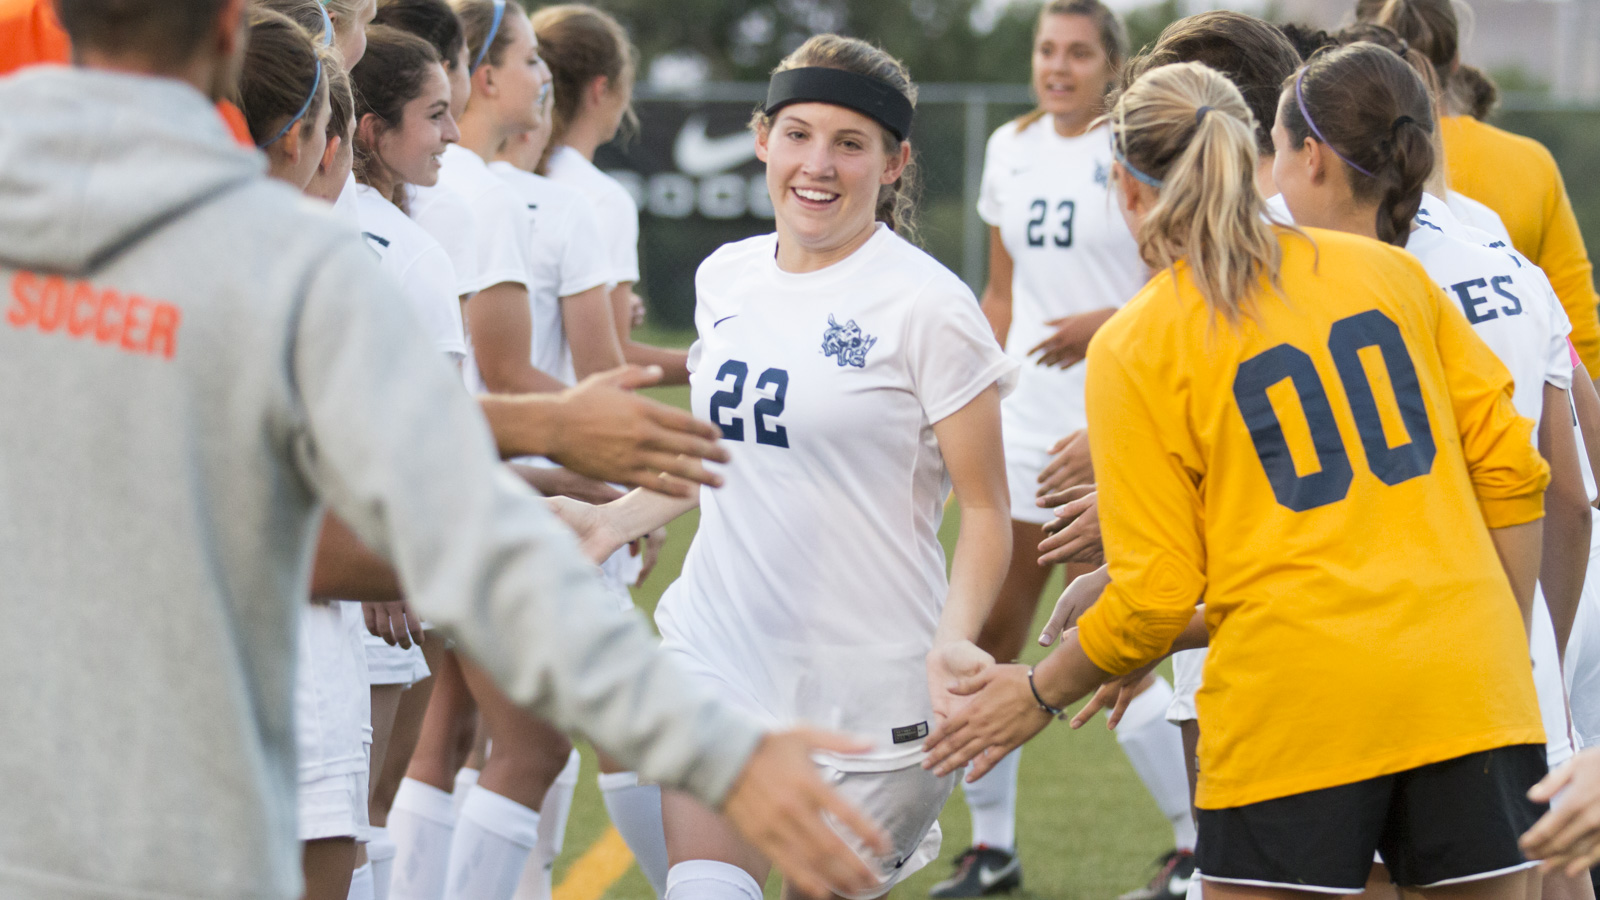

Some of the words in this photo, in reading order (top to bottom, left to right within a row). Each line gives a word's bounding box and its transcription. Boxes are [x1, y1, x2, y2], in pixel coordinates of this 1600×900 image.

[1027, 199, 1075, 247] 23
[8, 270, 182, 362] SOCCER
[1443, 275, 1523, 325] ES
[710, 359, 790, 449] 22
[1232, 309, 1437, 513] 00
